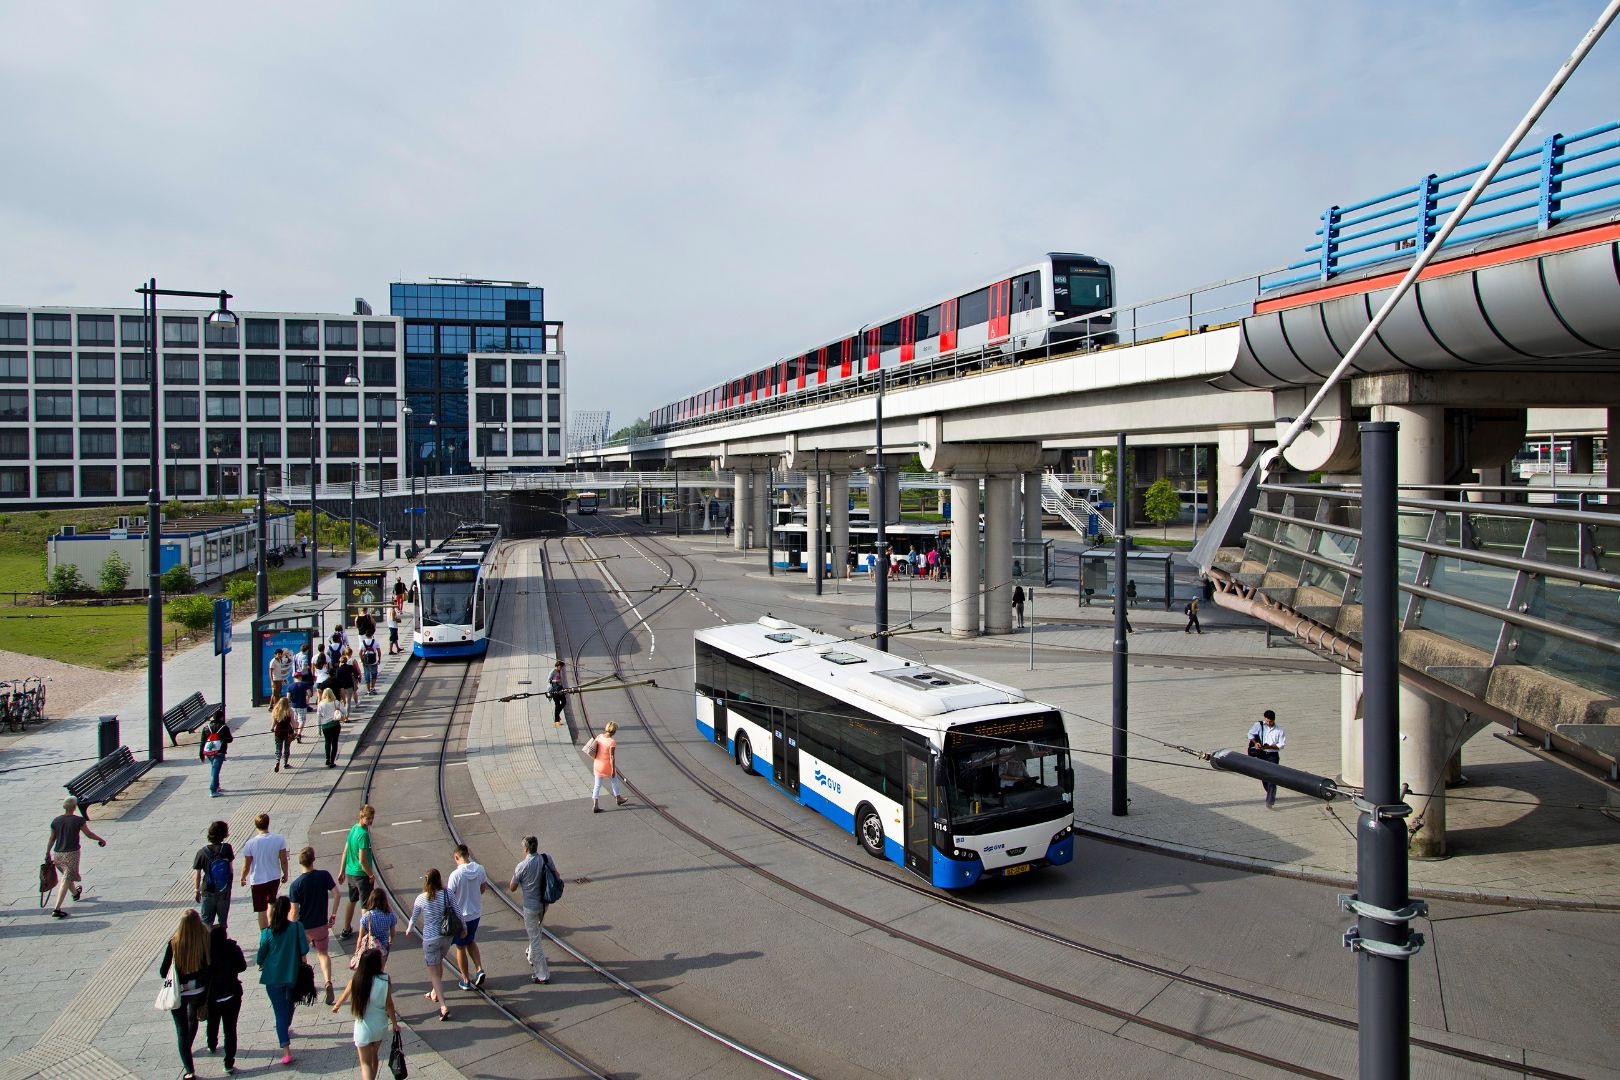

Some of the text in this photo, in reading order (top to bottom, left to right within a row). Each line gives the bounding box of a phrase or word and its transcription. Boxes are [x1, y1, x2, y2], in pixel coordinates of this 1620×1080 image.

[827, 778, 841, 794] GVB
[933, 822, 947, 832] 1114
[993, 843, 1005, 851] GVB
